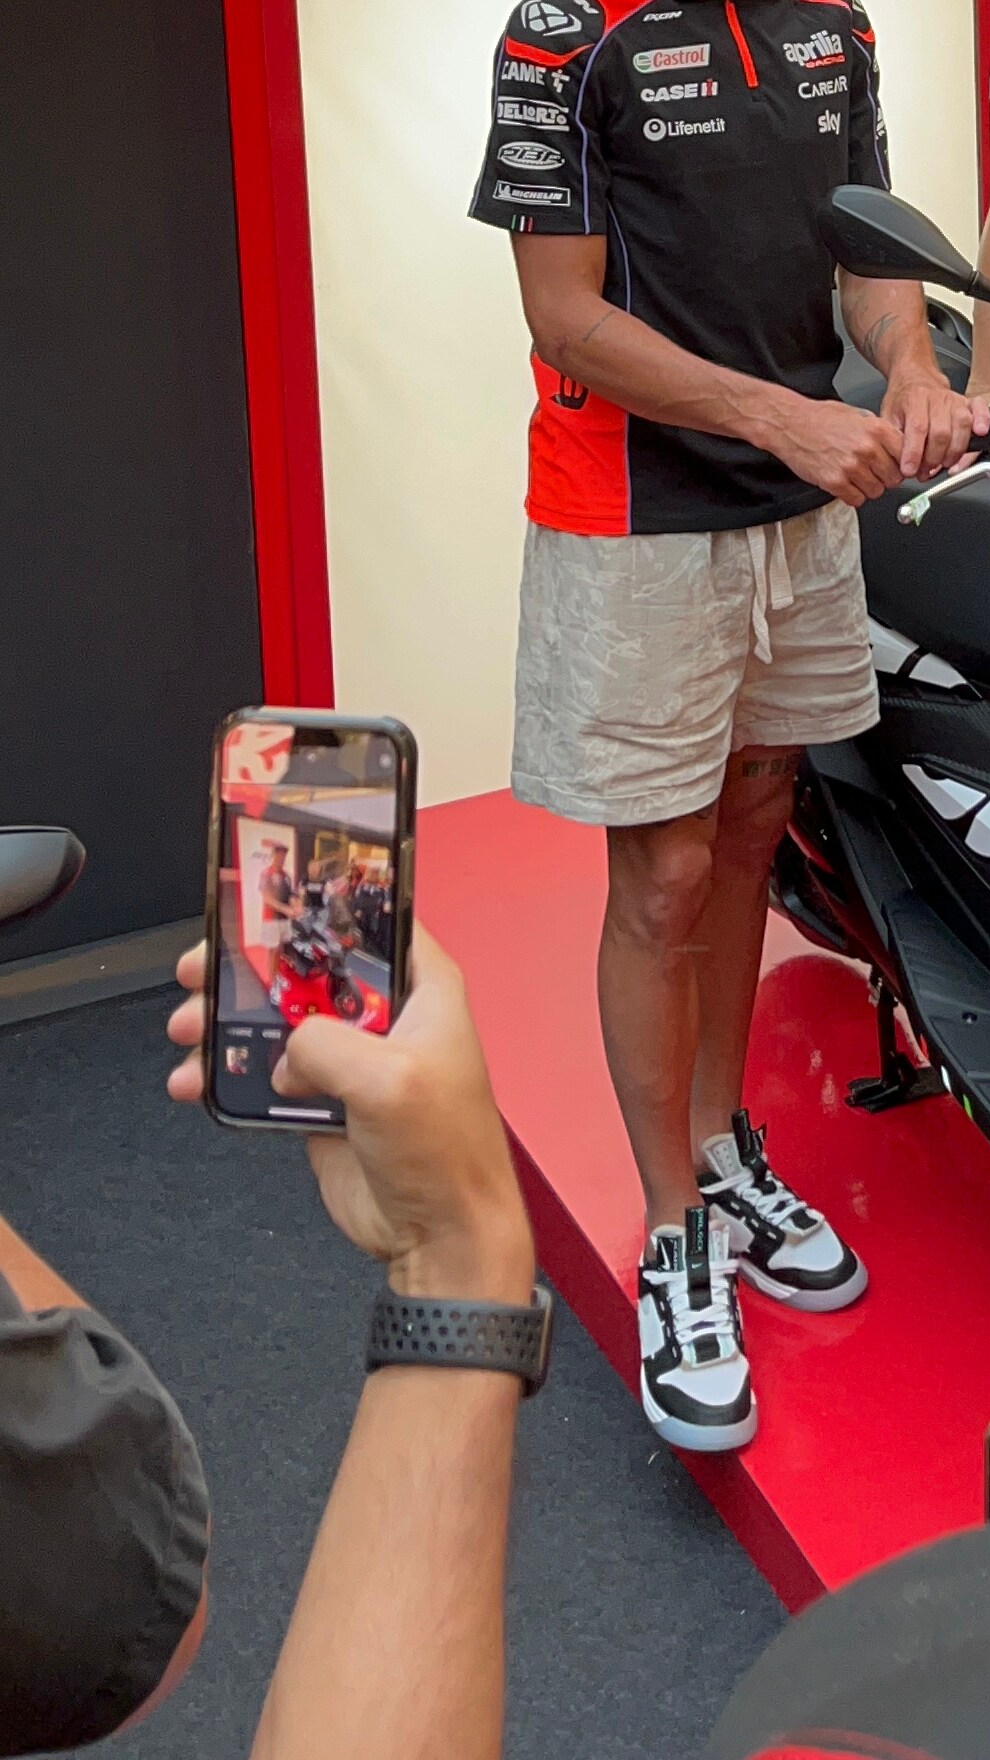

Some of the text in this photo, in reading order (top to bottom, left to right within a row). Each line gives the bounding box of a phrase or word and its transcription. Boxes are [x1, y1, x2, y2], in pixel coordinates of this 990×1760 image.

[653, 47, 706, 69] Castrol
[782, 29, 843, 67] aprilia
[640, 83, 699, 102] CASE
[817, 107, 842, 135] sky
[511, 189, 563, 201] MICHELIN
